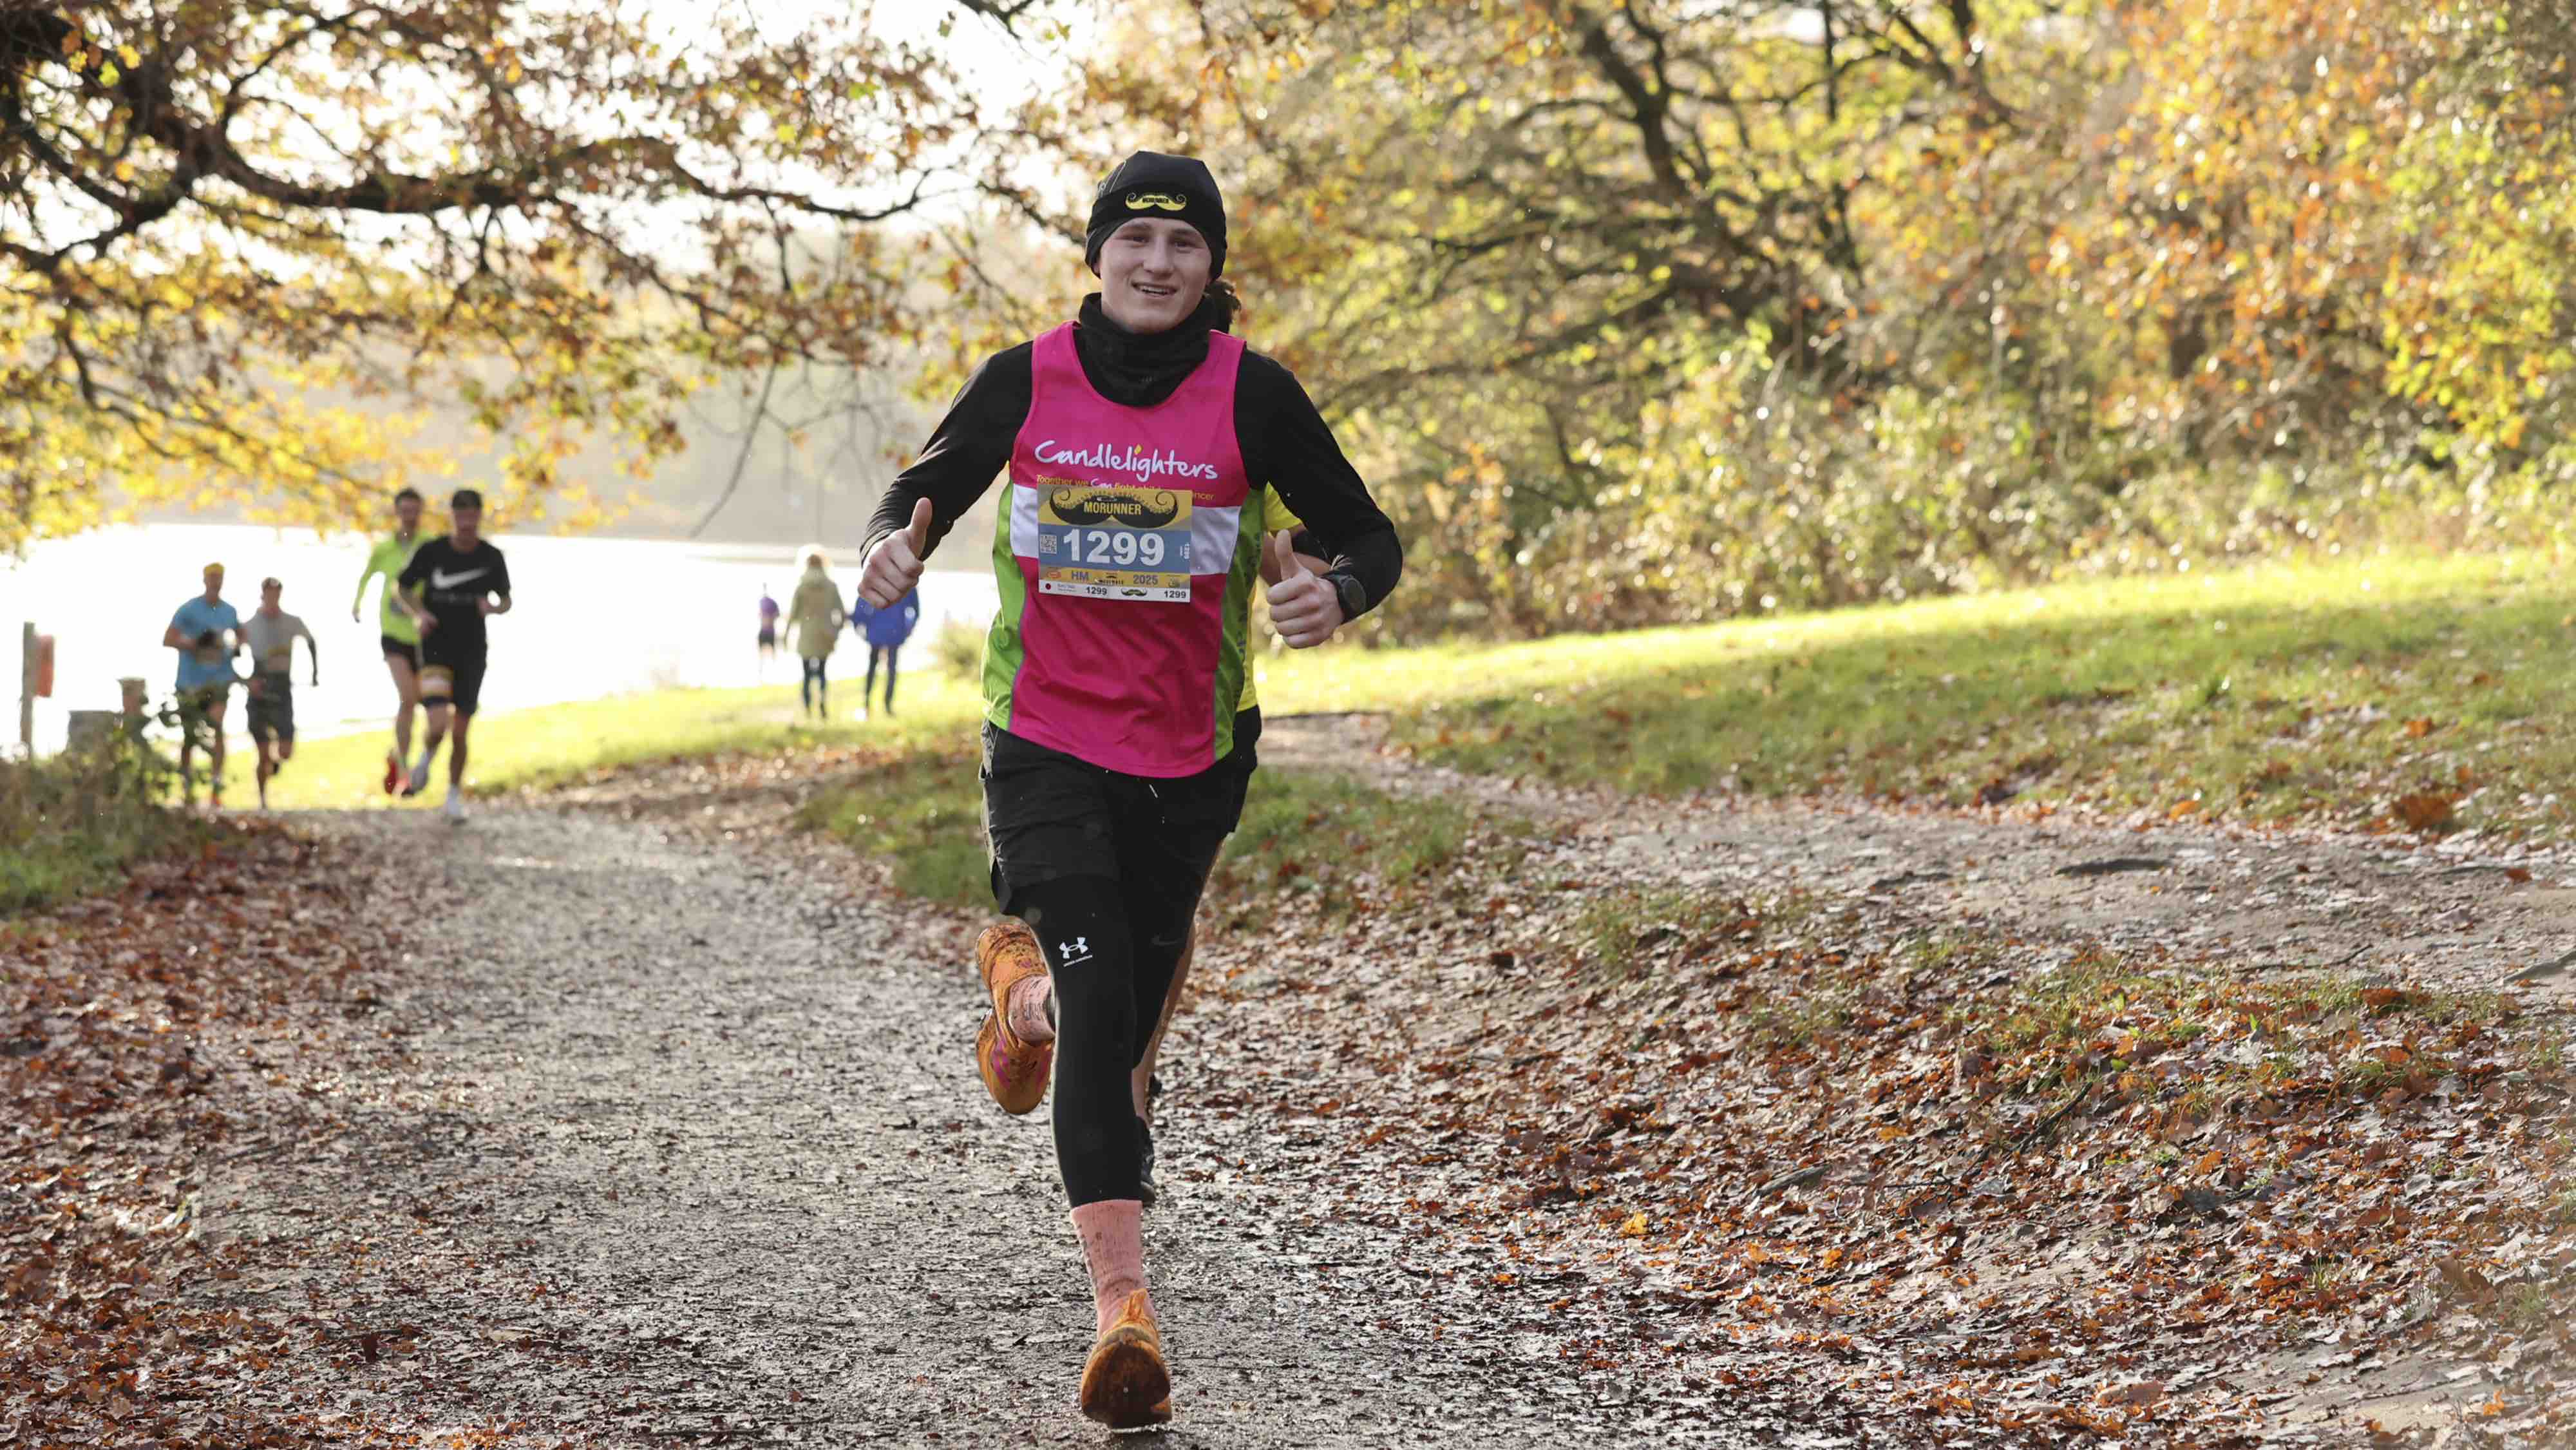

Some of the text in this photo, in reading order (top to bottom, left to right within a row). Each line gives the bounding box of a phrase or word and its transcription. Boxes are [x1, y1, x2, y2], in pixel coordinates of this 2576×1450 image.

[1034, 440, 1218, 482] Candlelighters
[1083, 501, 1142, 515] MORUNNER
[1063, 528, 1164, 566] 1299
[1071, 571, 1089, 581] HM
[1133, 574, 1158, 586] 2025
[1086, 586, 1108, 595] 1299
[1164, 590, 1186, 598] 1299
